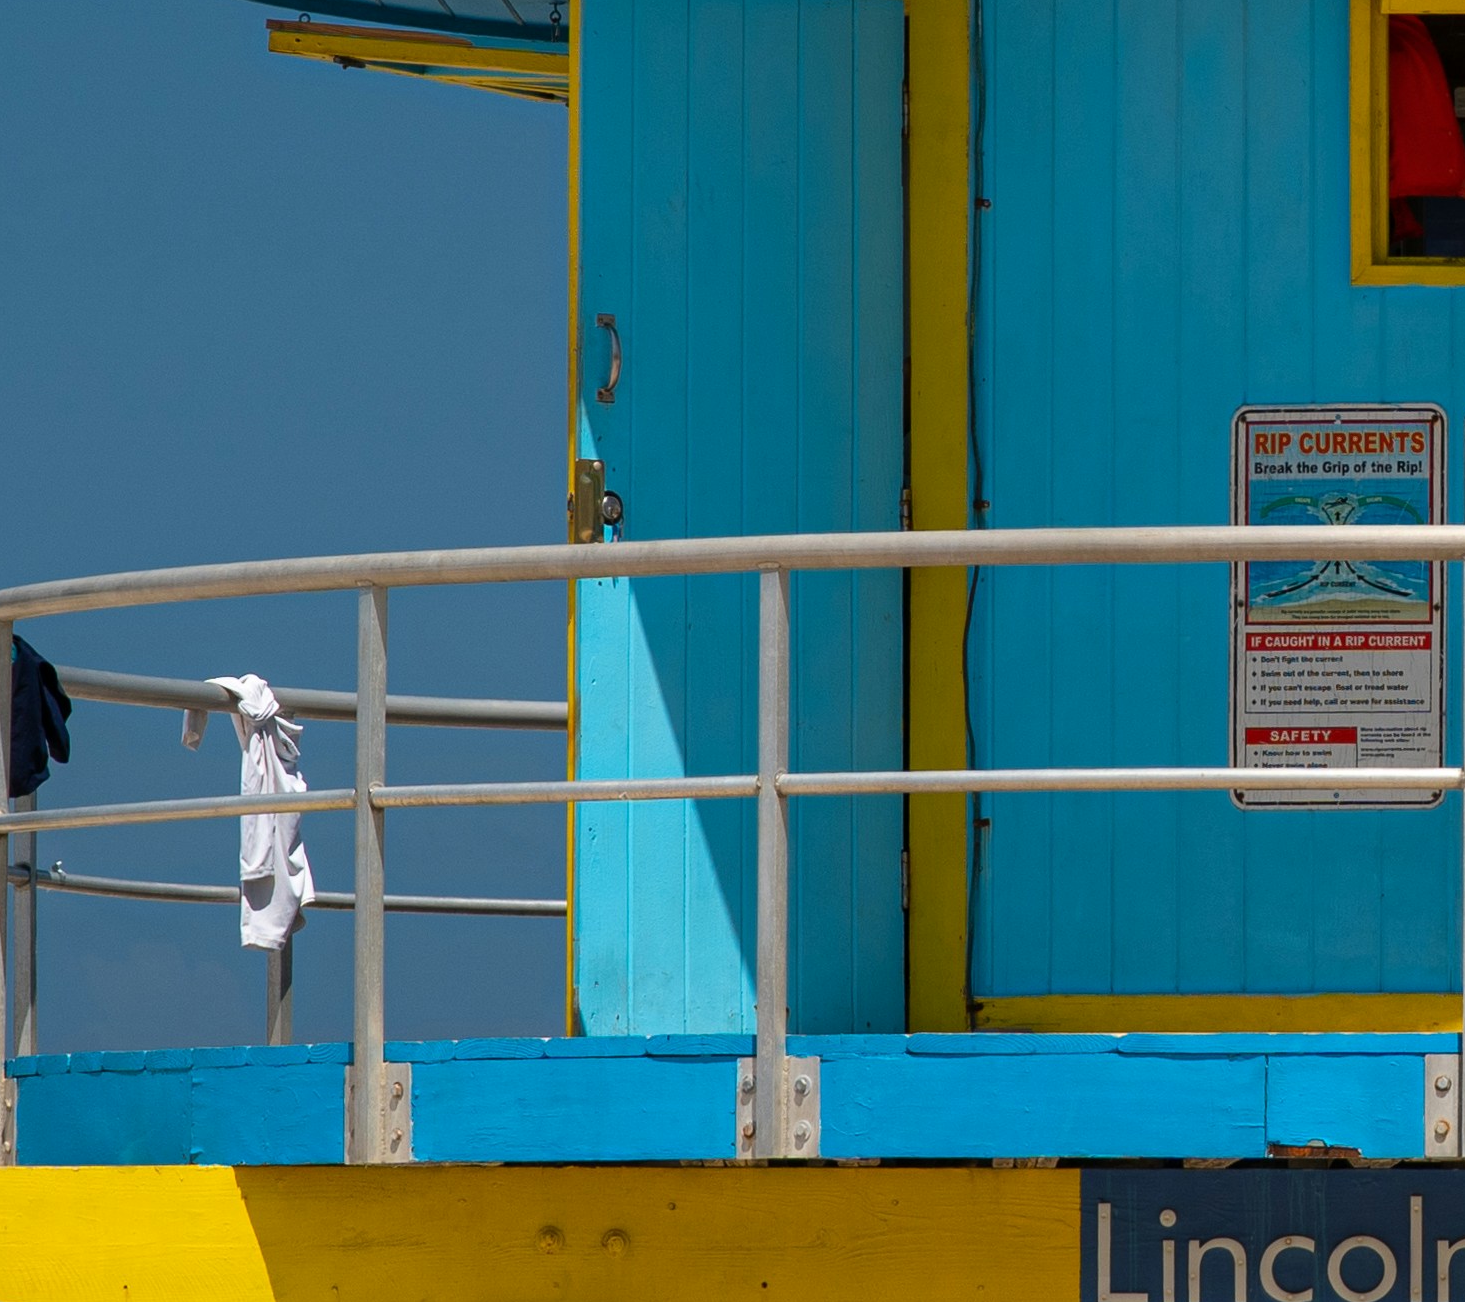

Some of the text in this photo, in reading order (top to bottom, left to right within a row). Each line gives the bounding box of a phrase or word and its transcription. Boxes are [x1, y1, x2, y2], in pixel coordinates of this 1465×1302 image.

[1254, 431, 1426, 456] RIP CURRENTS
[1254, 461, 1422, 476] Break the Grip of the Rip!
[1252, 636, 1426, 646] IF CAUGHT IN A RIP CURRENT
[1270, 730, 1332, 742] SAFETY
